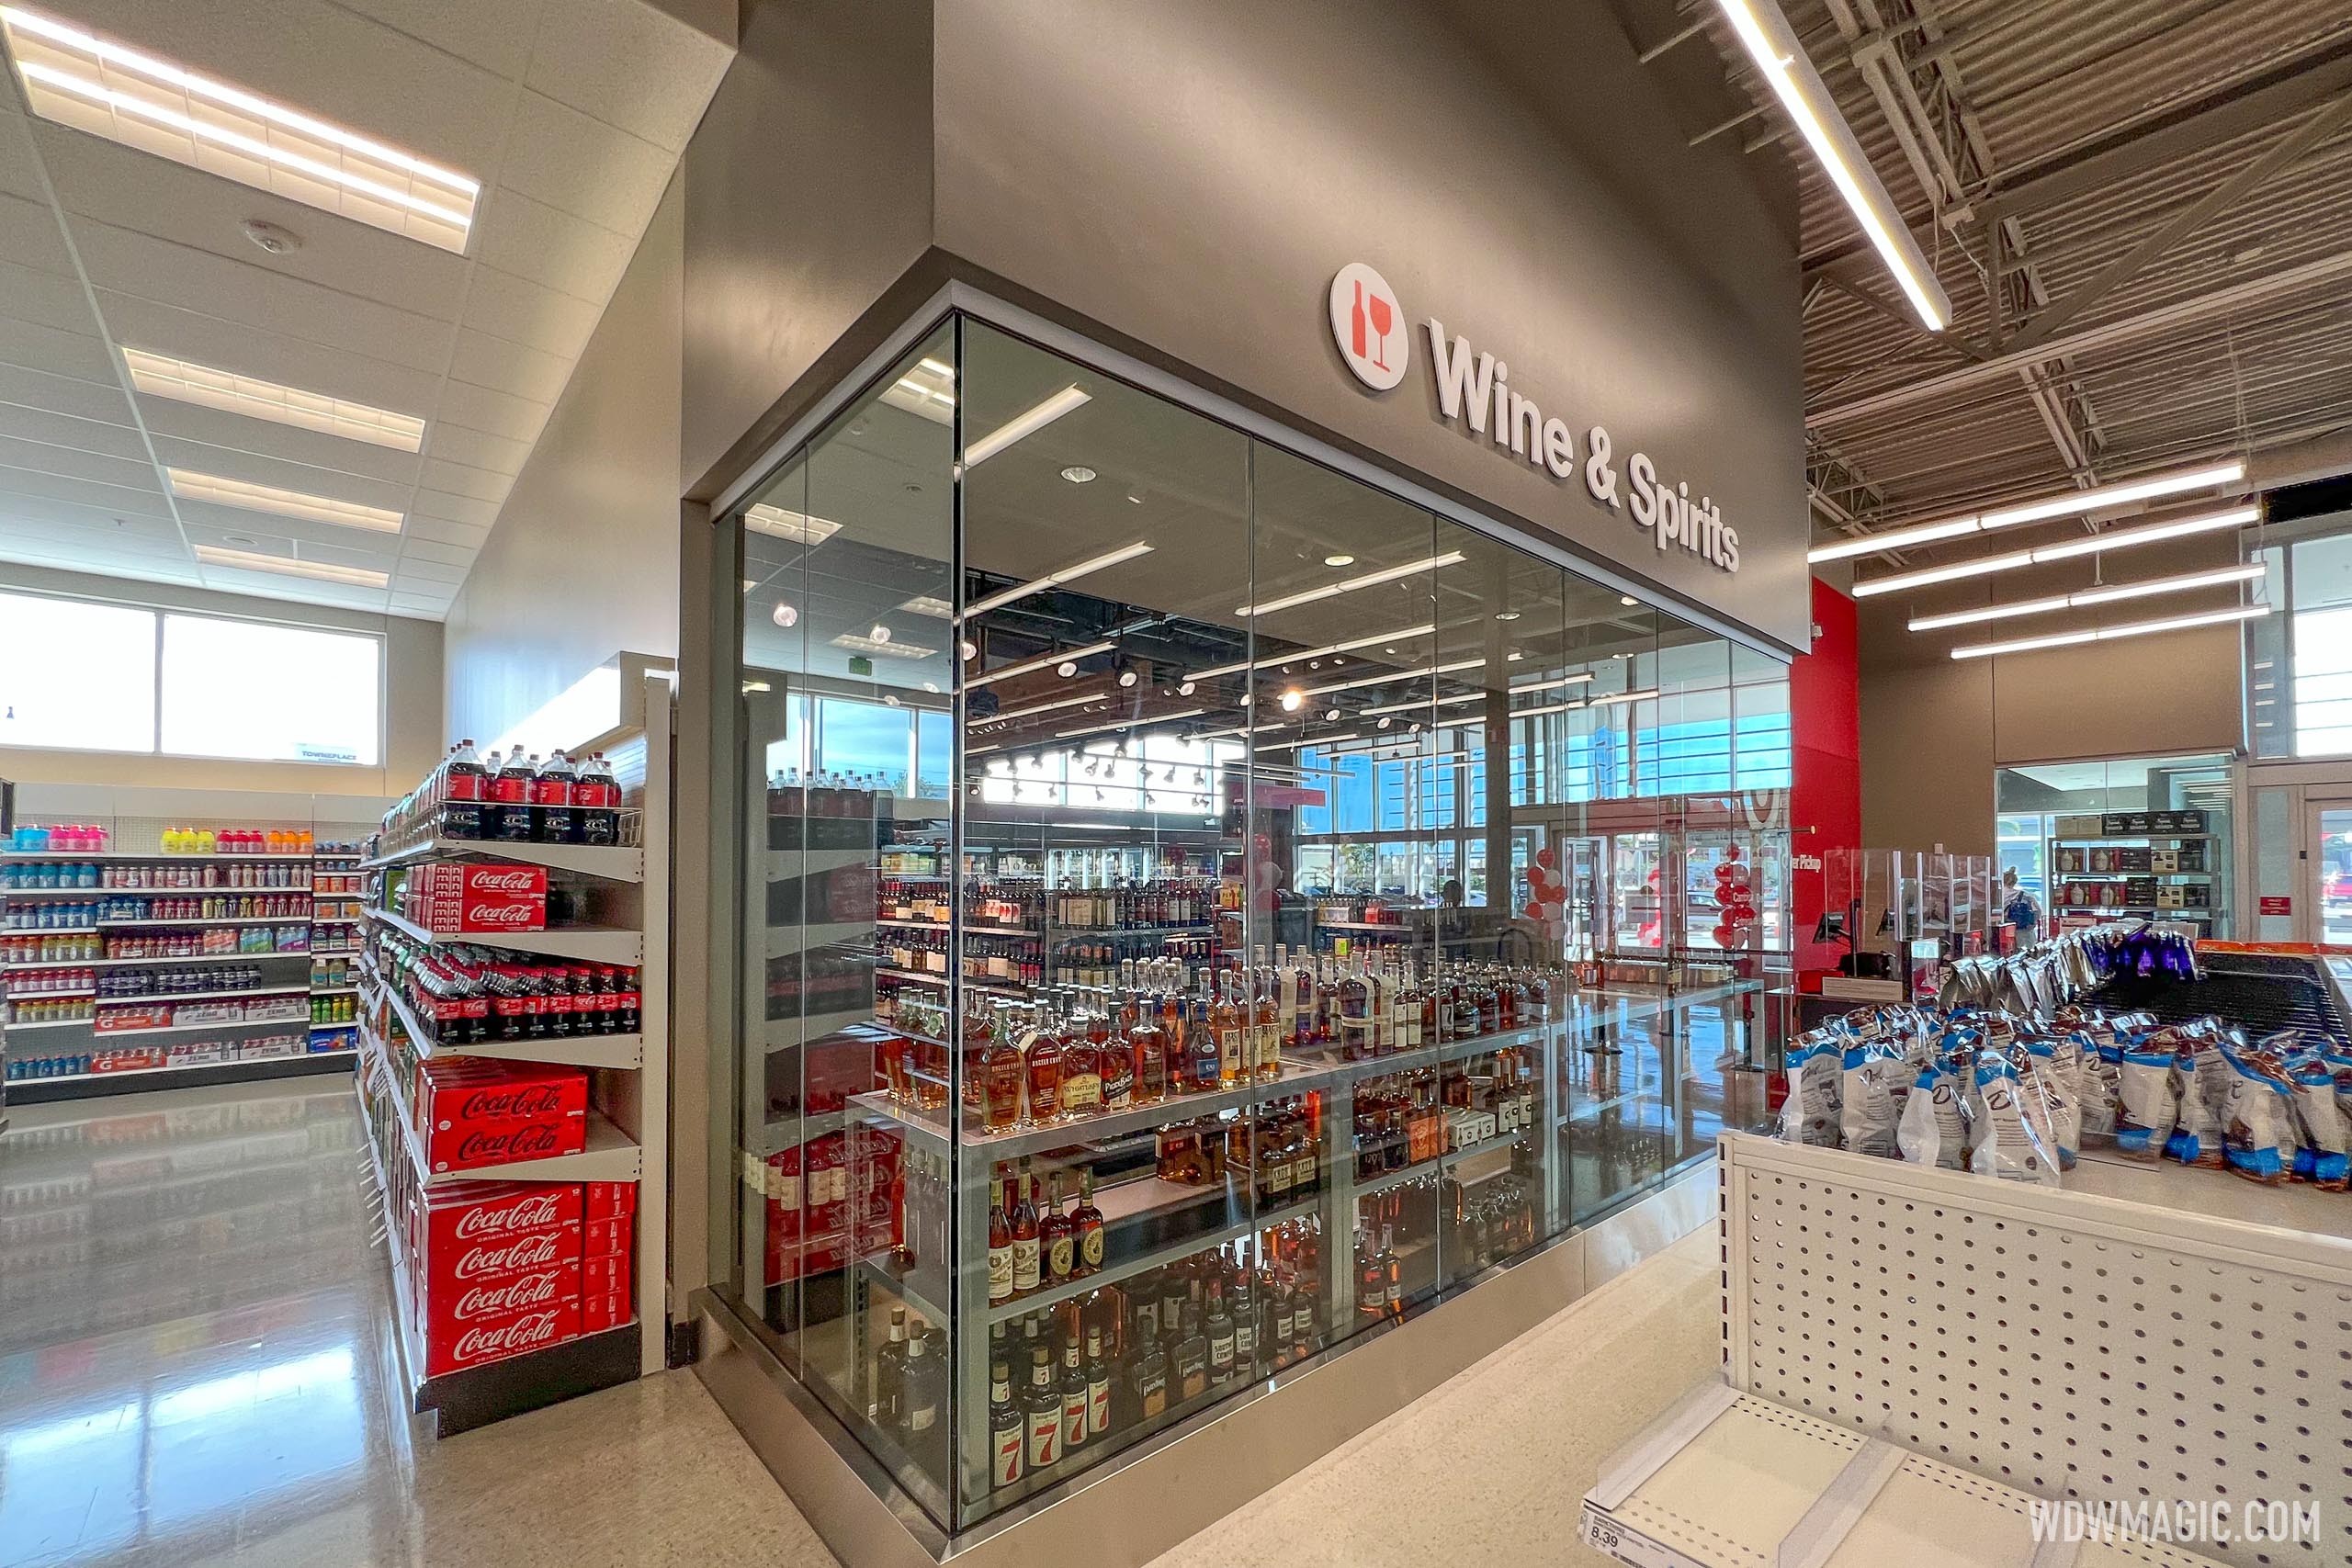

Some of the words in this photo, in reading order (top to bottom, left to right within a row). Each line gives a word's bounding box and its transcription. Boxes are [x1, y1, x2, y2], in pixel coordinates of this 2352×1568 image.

[1423, 316, 1574, 478] Wine
[1586, 425, 1621, 508] &
[1629, 452, 1739, 573] Spirits
[470, 870, 537, 889] Coca-Cola
[469, 904, 534, 922] Coca-Cola
[100, 1019, 113, 1028] G
[99, 1060, 112, 1070] G
[461, 1084, 563, 1120] Coca-Cola
[458, 1123, 561, 1161] Coca-Cola
[456, 1193, 563, 1239] Coca-Cola
[455, 1232, 562, 1279] Coca-Cola
[477, 1232, 514, 1242] ORIGINAL
[454, 1269, 560, 1320] Coca-Cola
[476, 1271, 513, 1282] ORIGINAL
[454, 1308, 561, 1360] Coca-Cola
[475, 1311, 513, 1322] ORIGINAL
[1066, 1404, 1086, 1441] 7
[1094, 1389, 1108, 1427] 7
[1001, 1438, 1021, 1482] 7
[1035, 1422, 1058, 1462] 7
[1591, 1526, 1618, 1548] 8.39
